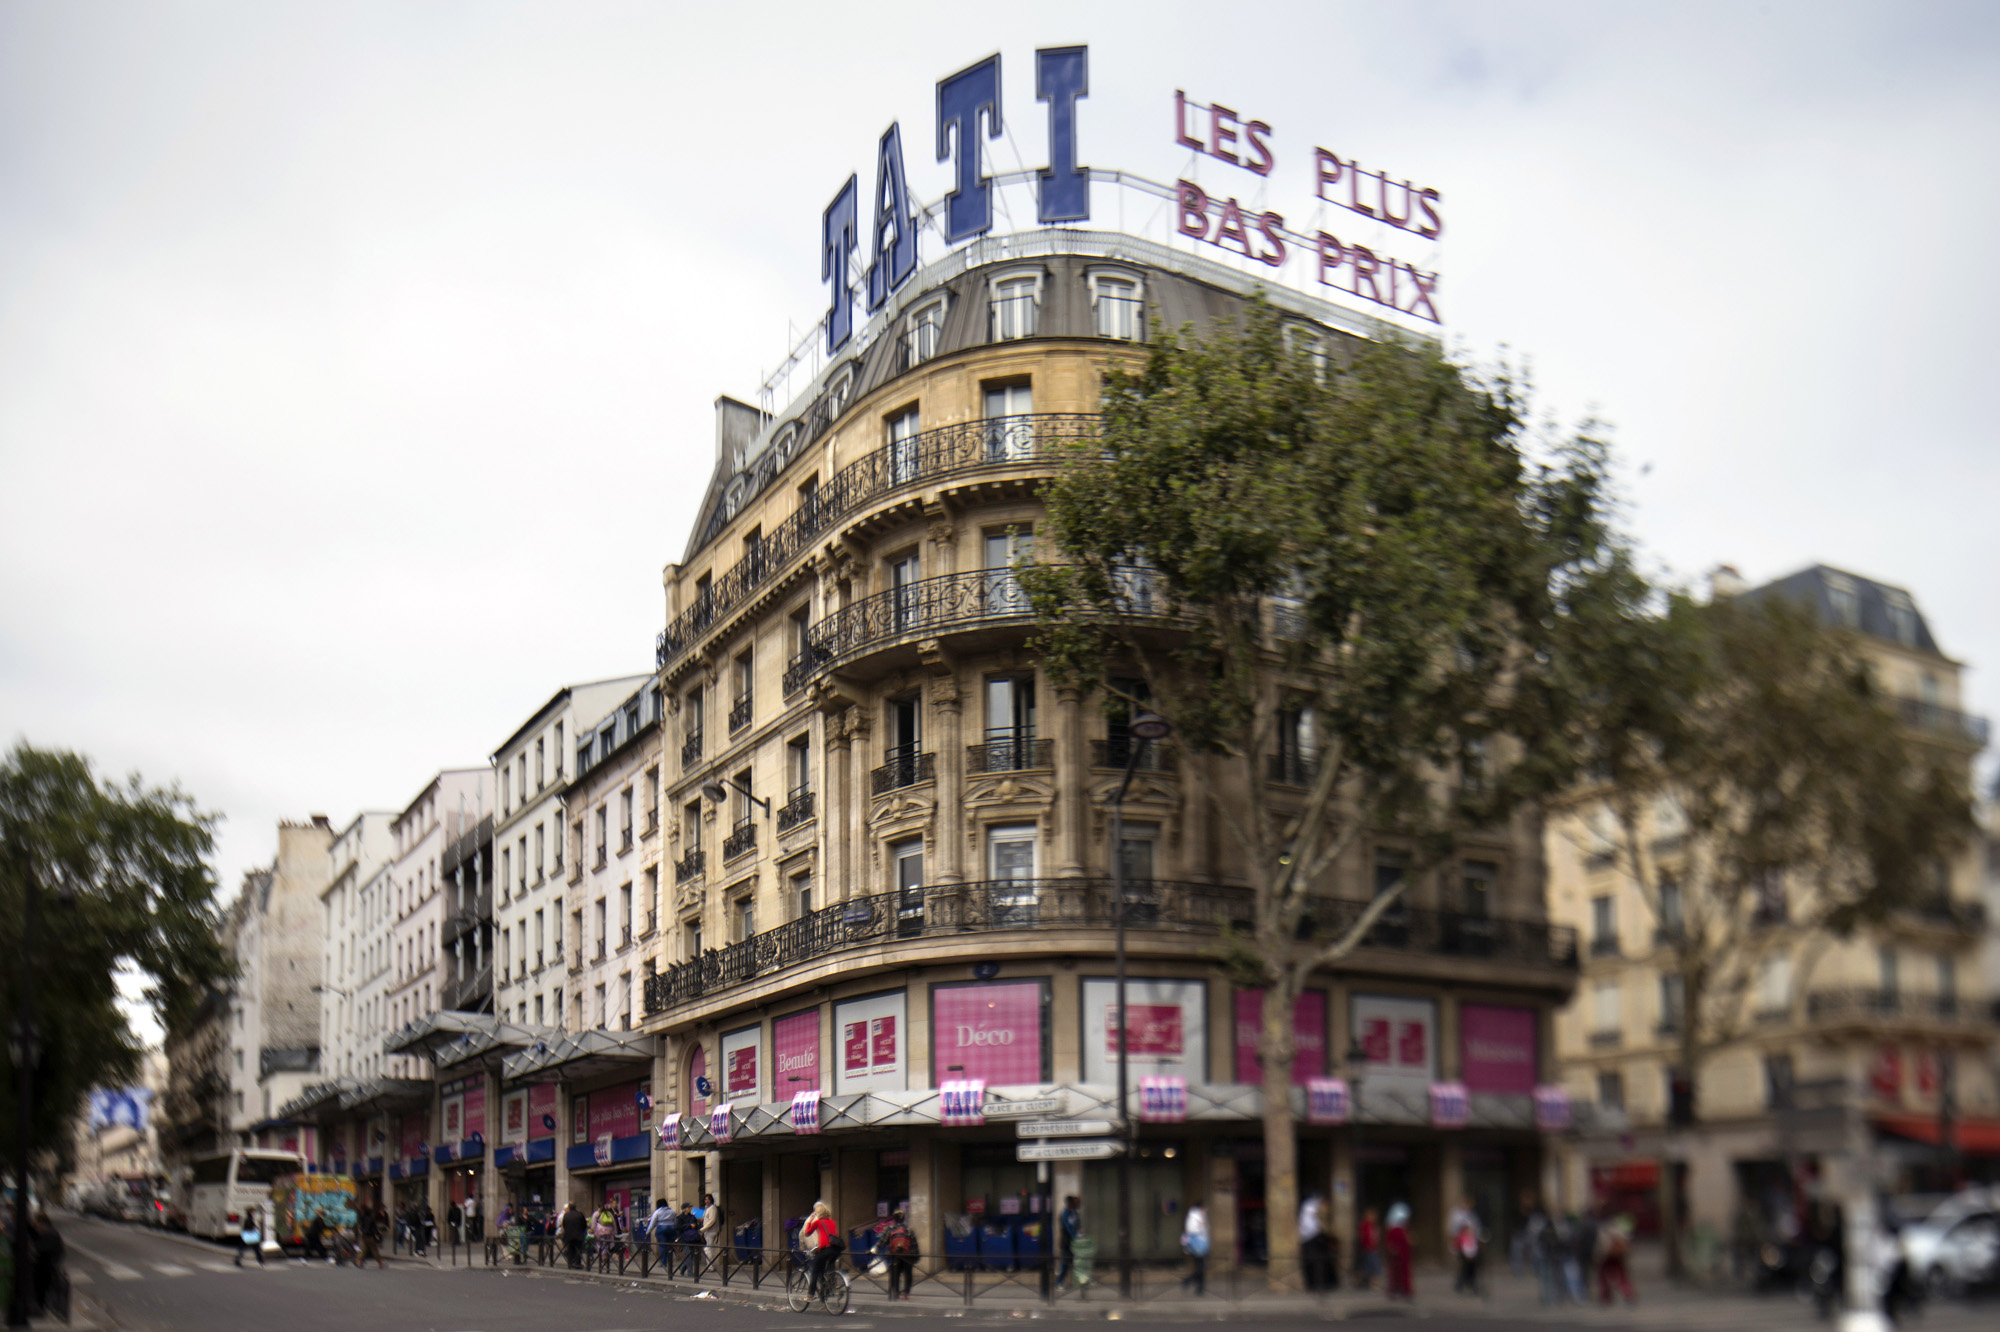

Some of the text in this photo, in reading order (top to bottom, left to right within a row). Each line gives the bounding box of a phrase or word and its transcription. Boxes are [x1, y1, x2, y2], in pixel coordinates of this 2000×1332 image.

[1174, 88, 1442, 241] LES PLUS
[822, 45, 1090, 356] TATI
[1178, 178, 1442, 325] BAS PRIX
[955, 1023, 1015, 1047] Déco
[779, 1046, 816, 1074] Beauté
[701, 1081, 708, 1091] 2
[793, 1101, 817, 1126] TATI
[944, 1090, 979, 1116] TATI
[987, 1104, 1012, 1113] PLACE
[1026, 1101, 1053, 1111] CLICHY
